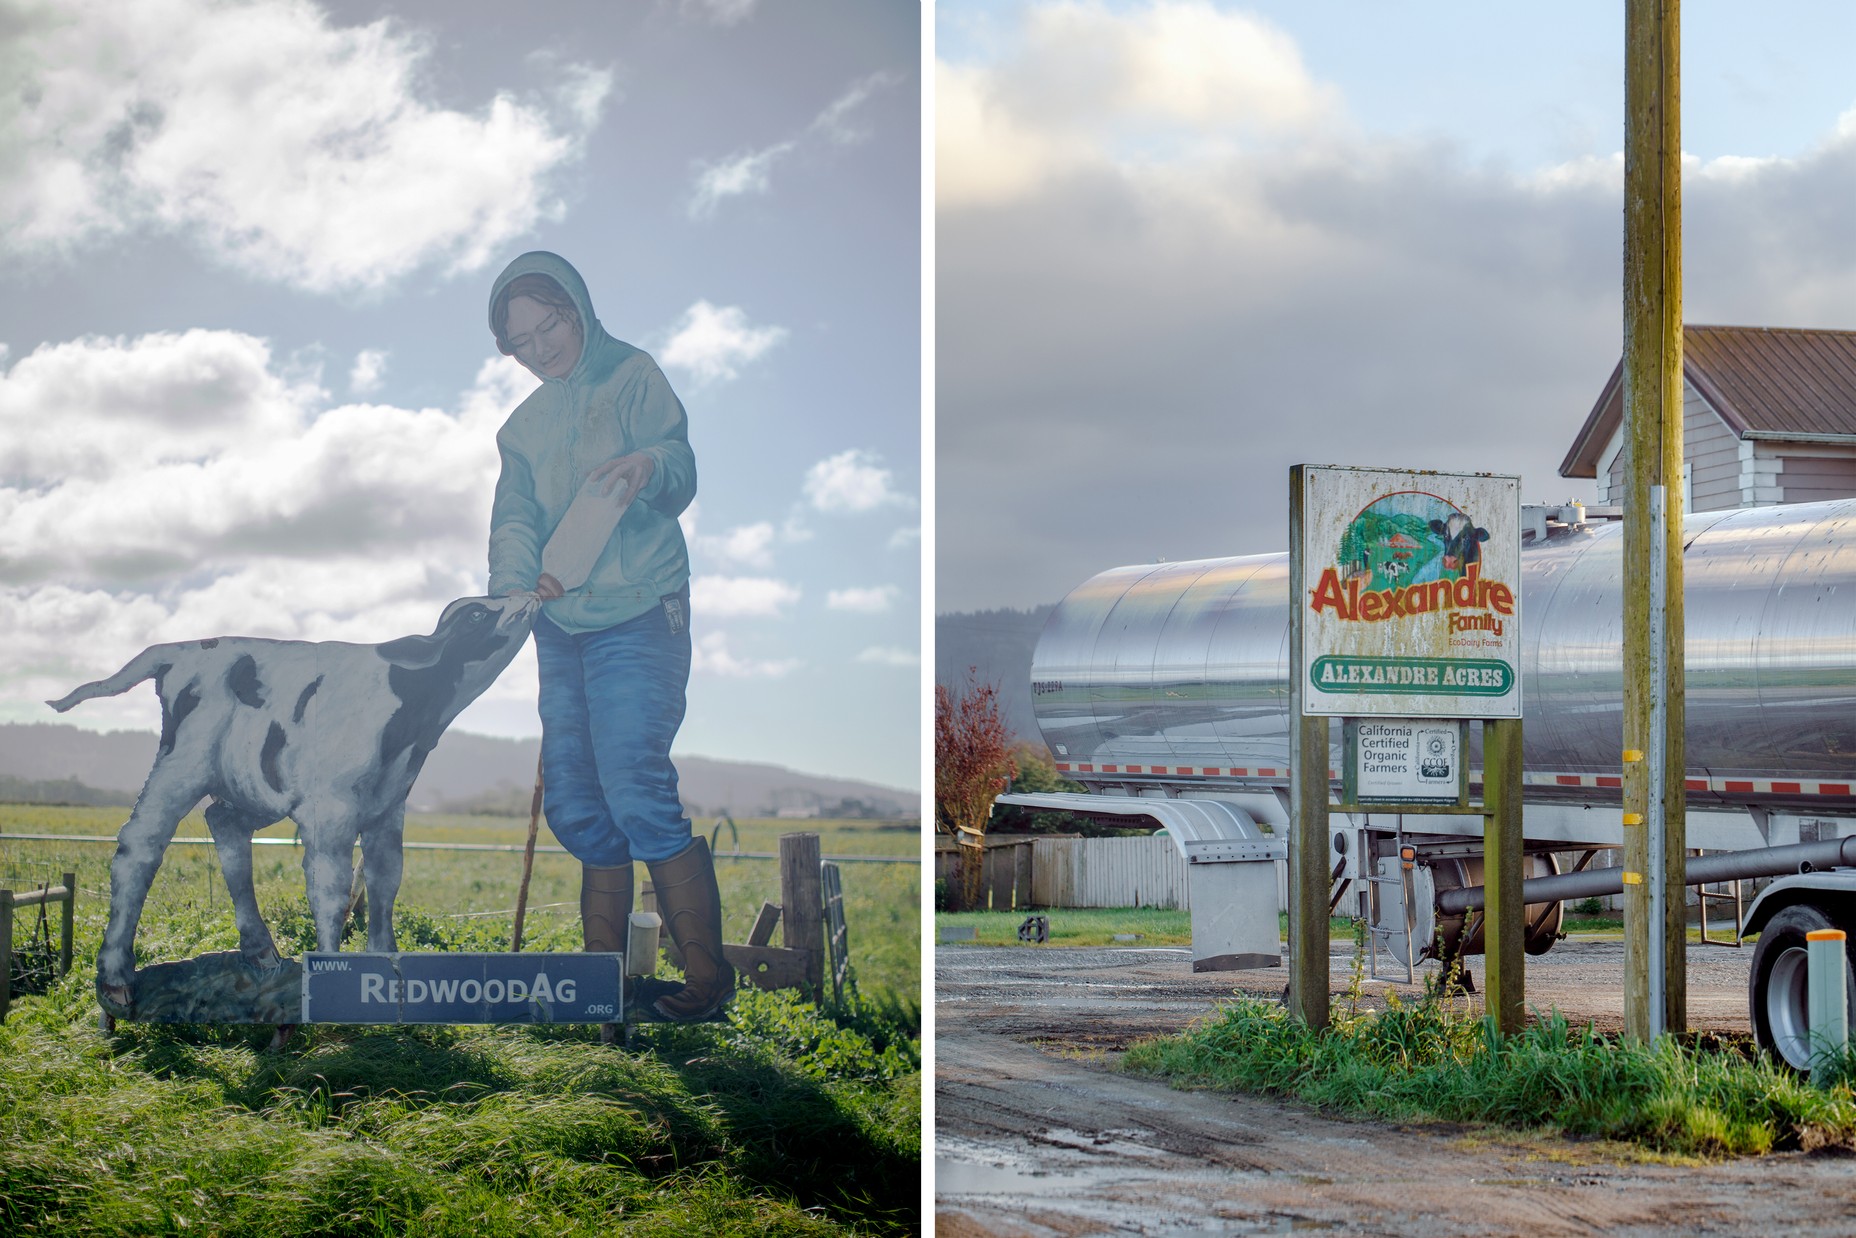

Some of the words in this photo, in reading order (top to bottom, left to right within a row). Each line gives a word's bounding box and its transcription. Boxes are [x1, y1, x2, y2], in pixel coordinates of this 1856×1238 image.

[1311, 563, 1515, 622] Alexandre
[1448, 612, 1503, 636] Family
[1482, 639, 1503, 647] Farms
[1320, 662, 1438, 686] ALEXANDRE
[1442, 667, 1504, 688] ACRES
[1358, 725, 1412, 737] California
[1361, 738, 1409, 749] Certified
[1364, 750, 1407, 763] Organic
[1364, 763, 1407, 773] Farmers
[1423, 757, 1448, 769] CCOF
[584, 1004, 613, 1015] .ORG
